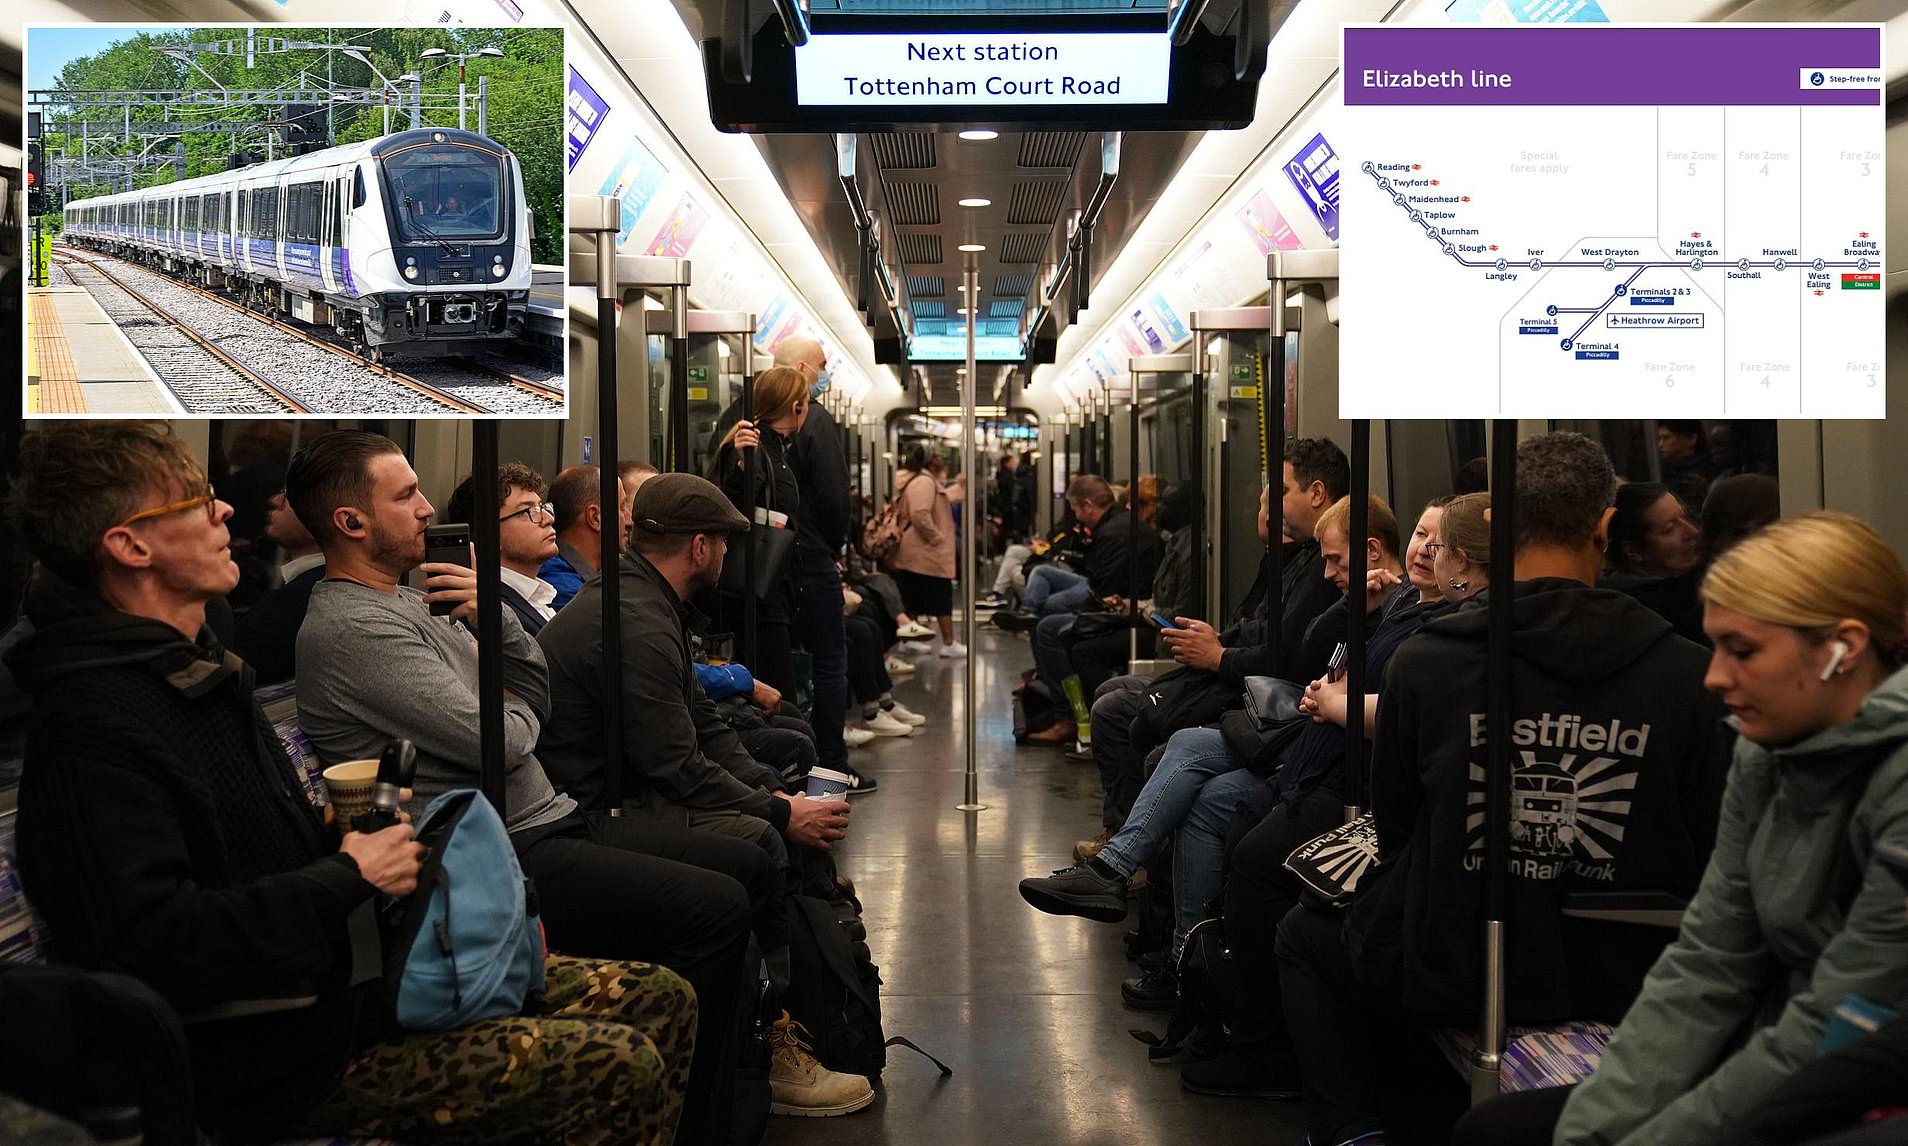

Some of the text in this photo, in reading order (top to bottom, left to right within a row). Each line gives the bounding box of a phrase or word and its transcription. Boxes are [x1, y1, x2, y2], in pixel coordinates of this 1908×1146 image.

[907, 42, 1058, 61] Next station
[843, 76, 1121, 96] Tottenham Court Road
[1468, 712, 1651, 758] Estfield
[1297, 833, 1338, 860] Punk
[1462, 853, 1521, 876] Urn
